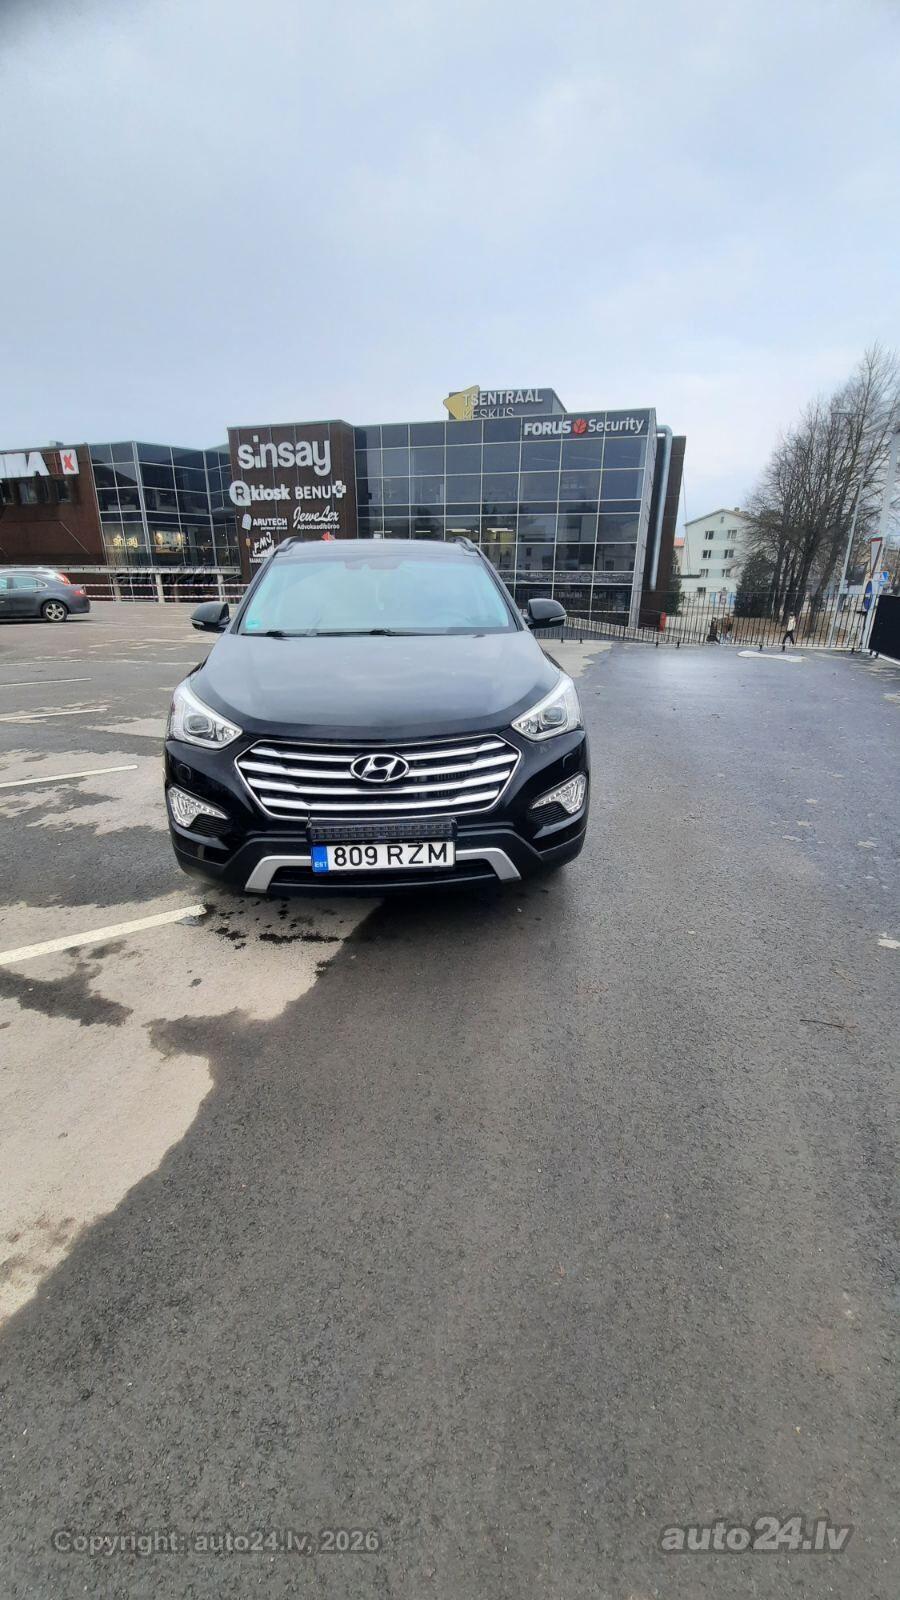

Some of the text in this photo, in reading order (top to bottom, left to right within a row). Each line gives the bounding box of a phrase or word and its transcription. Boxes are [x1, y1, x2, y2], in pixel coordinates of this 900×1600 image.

[463, 389, 543, 407] TSENTRAAL
[463, 407, 515, 420] KESKUS
[524, 417, 644, 436] FORUS Security
[238, 435, 331, 476] sinsay
[295, 485, 331, 500] BENU
[253, 517, 288, 526] ARUTECH
[334, 846, 378, 867] 809
[387, 843, 447, 865] RZM
